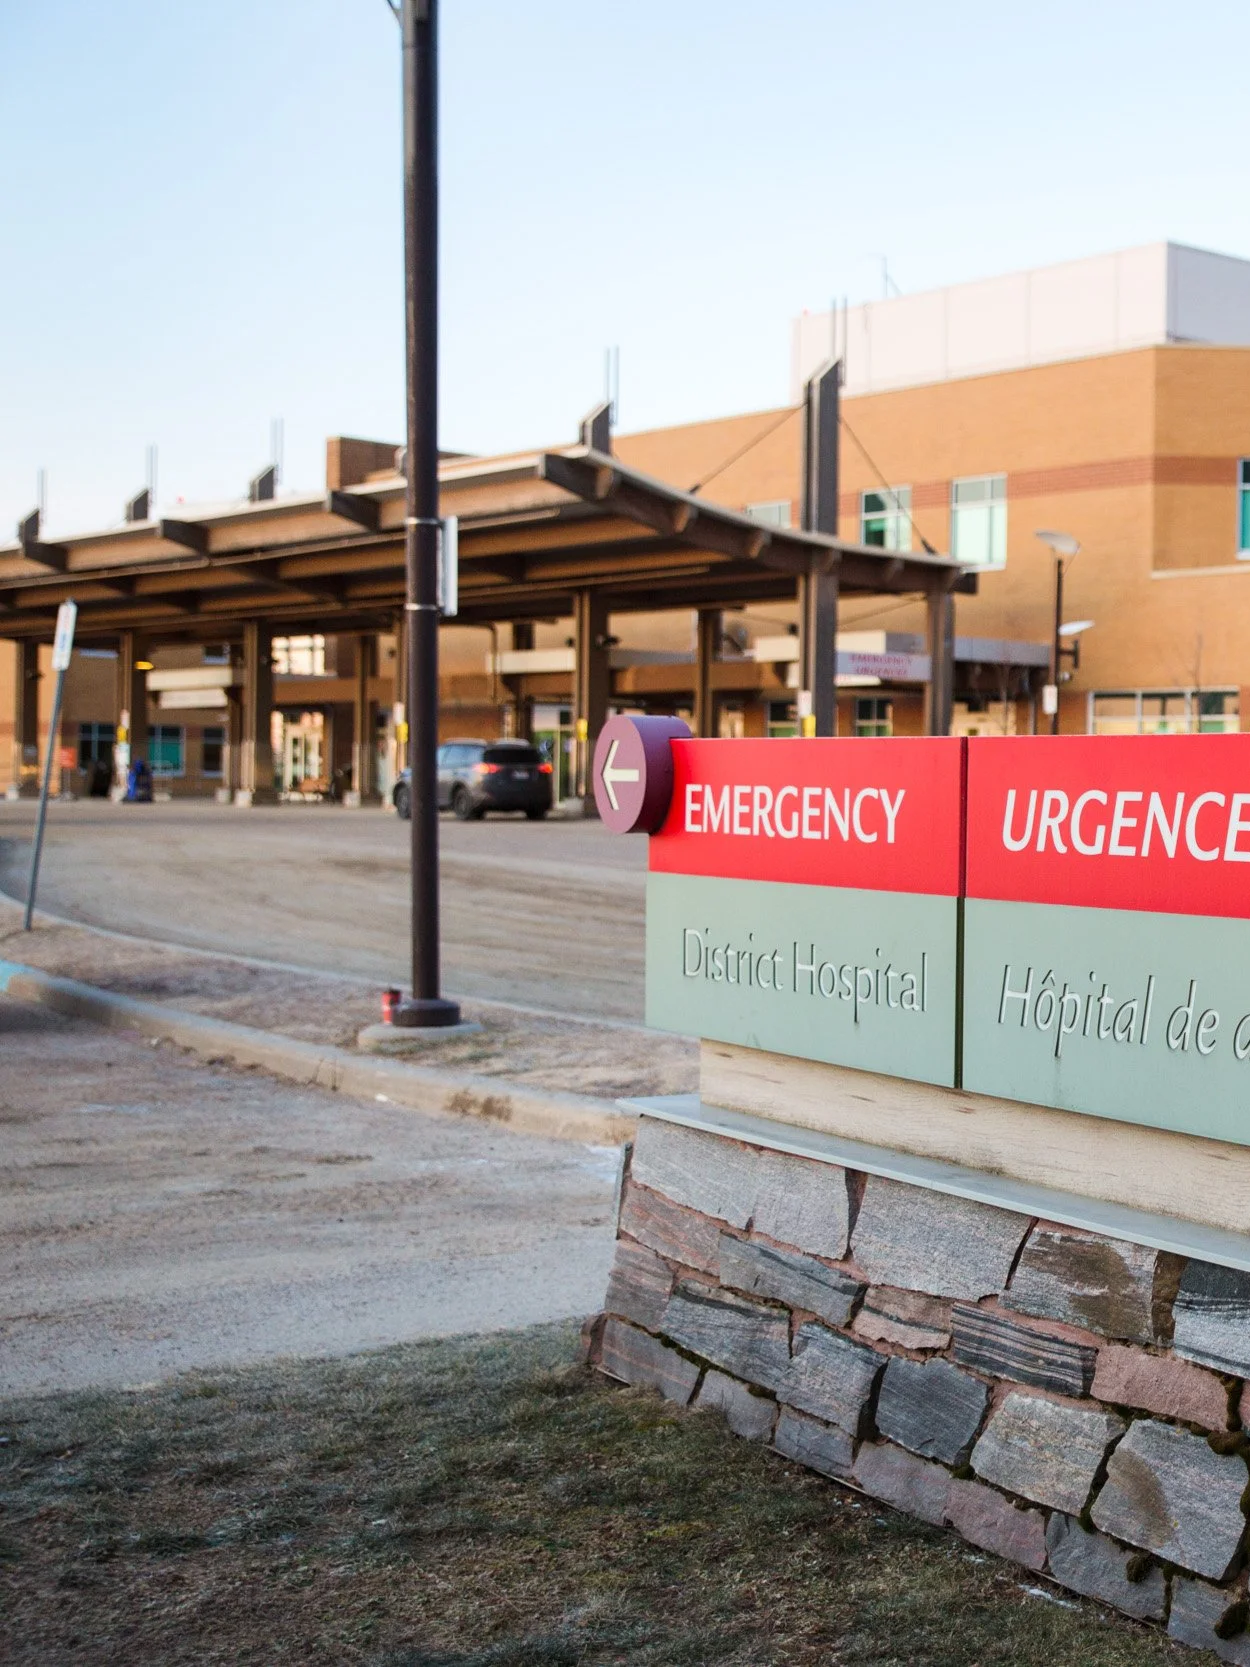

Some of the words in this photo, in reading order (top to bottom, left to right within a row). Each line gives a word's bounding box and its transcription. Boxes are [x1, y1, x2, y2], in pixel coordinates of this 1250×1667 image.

[684, 783, 906, 844] EMERGENCY
[683, 928, 784, 991] District
[793, 941, 928, 1023] Hospital
[998, 964, 1156, 1058] Hôpital
[1166, 979, 1220, 1055] de
